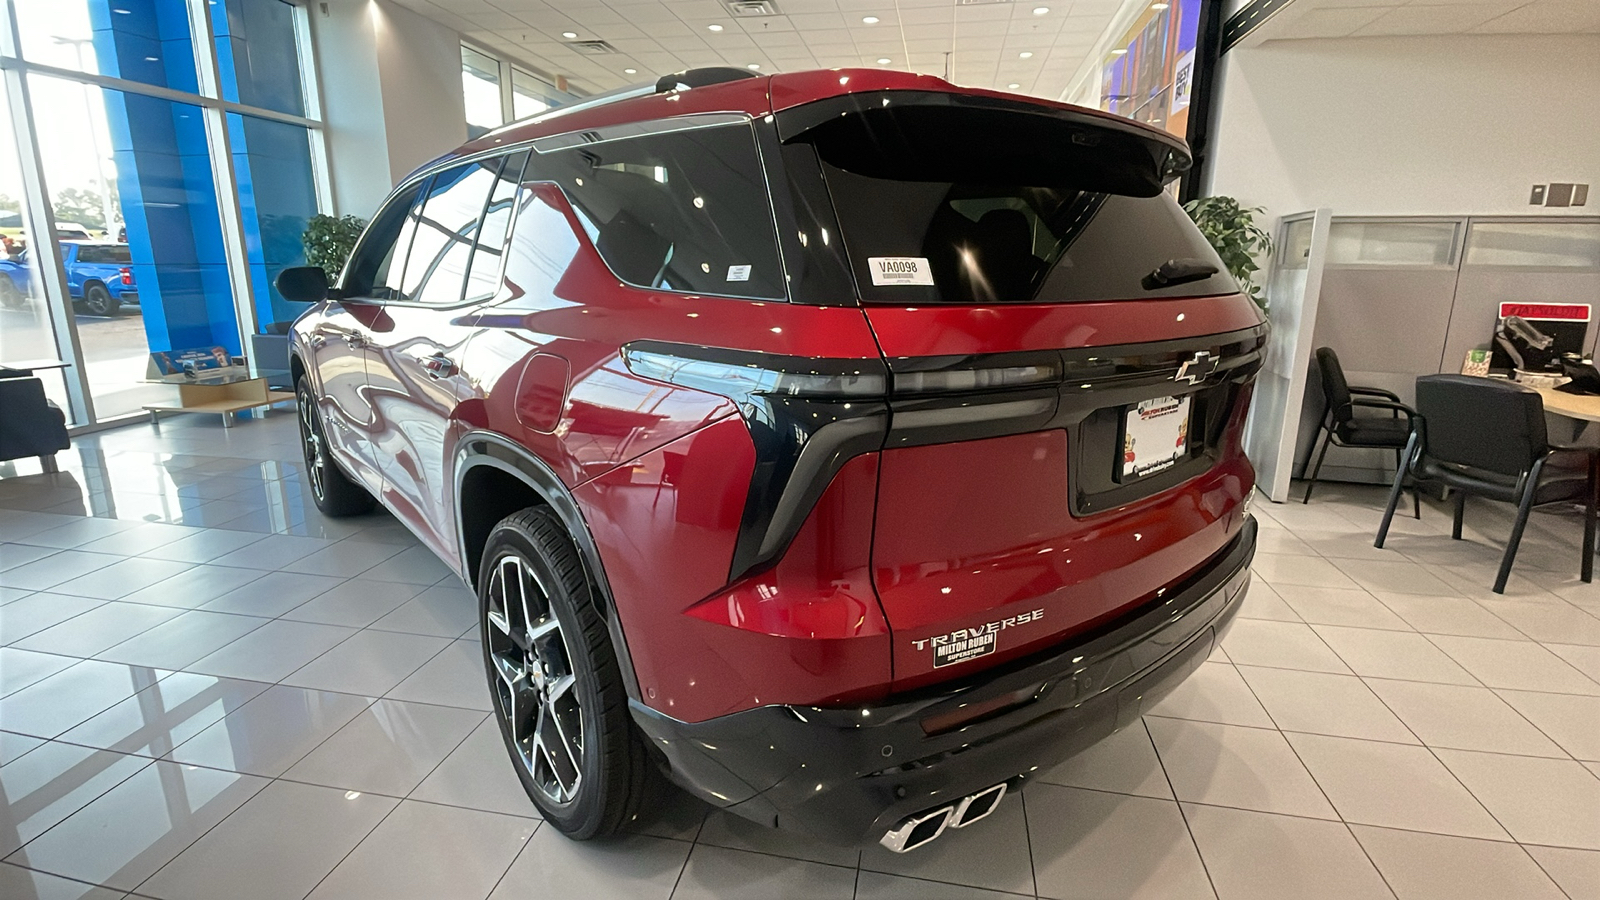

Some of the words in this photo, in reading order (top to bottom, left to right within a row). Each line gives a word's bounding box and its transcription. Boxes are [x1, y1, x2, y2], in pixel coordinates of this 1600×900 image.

[1176, 62, 1191, 87] BEST
[1175, 80, 1188, 101] BUY
[879, 261, 918, 273] VA0098
[912, 608, 1044, 651] TRAVERSE
[937, 641, 967, 657] MILTON
[968, 633, 994, 649] RUBEN
[947, 646, 985, 661] SUPERSTORE
